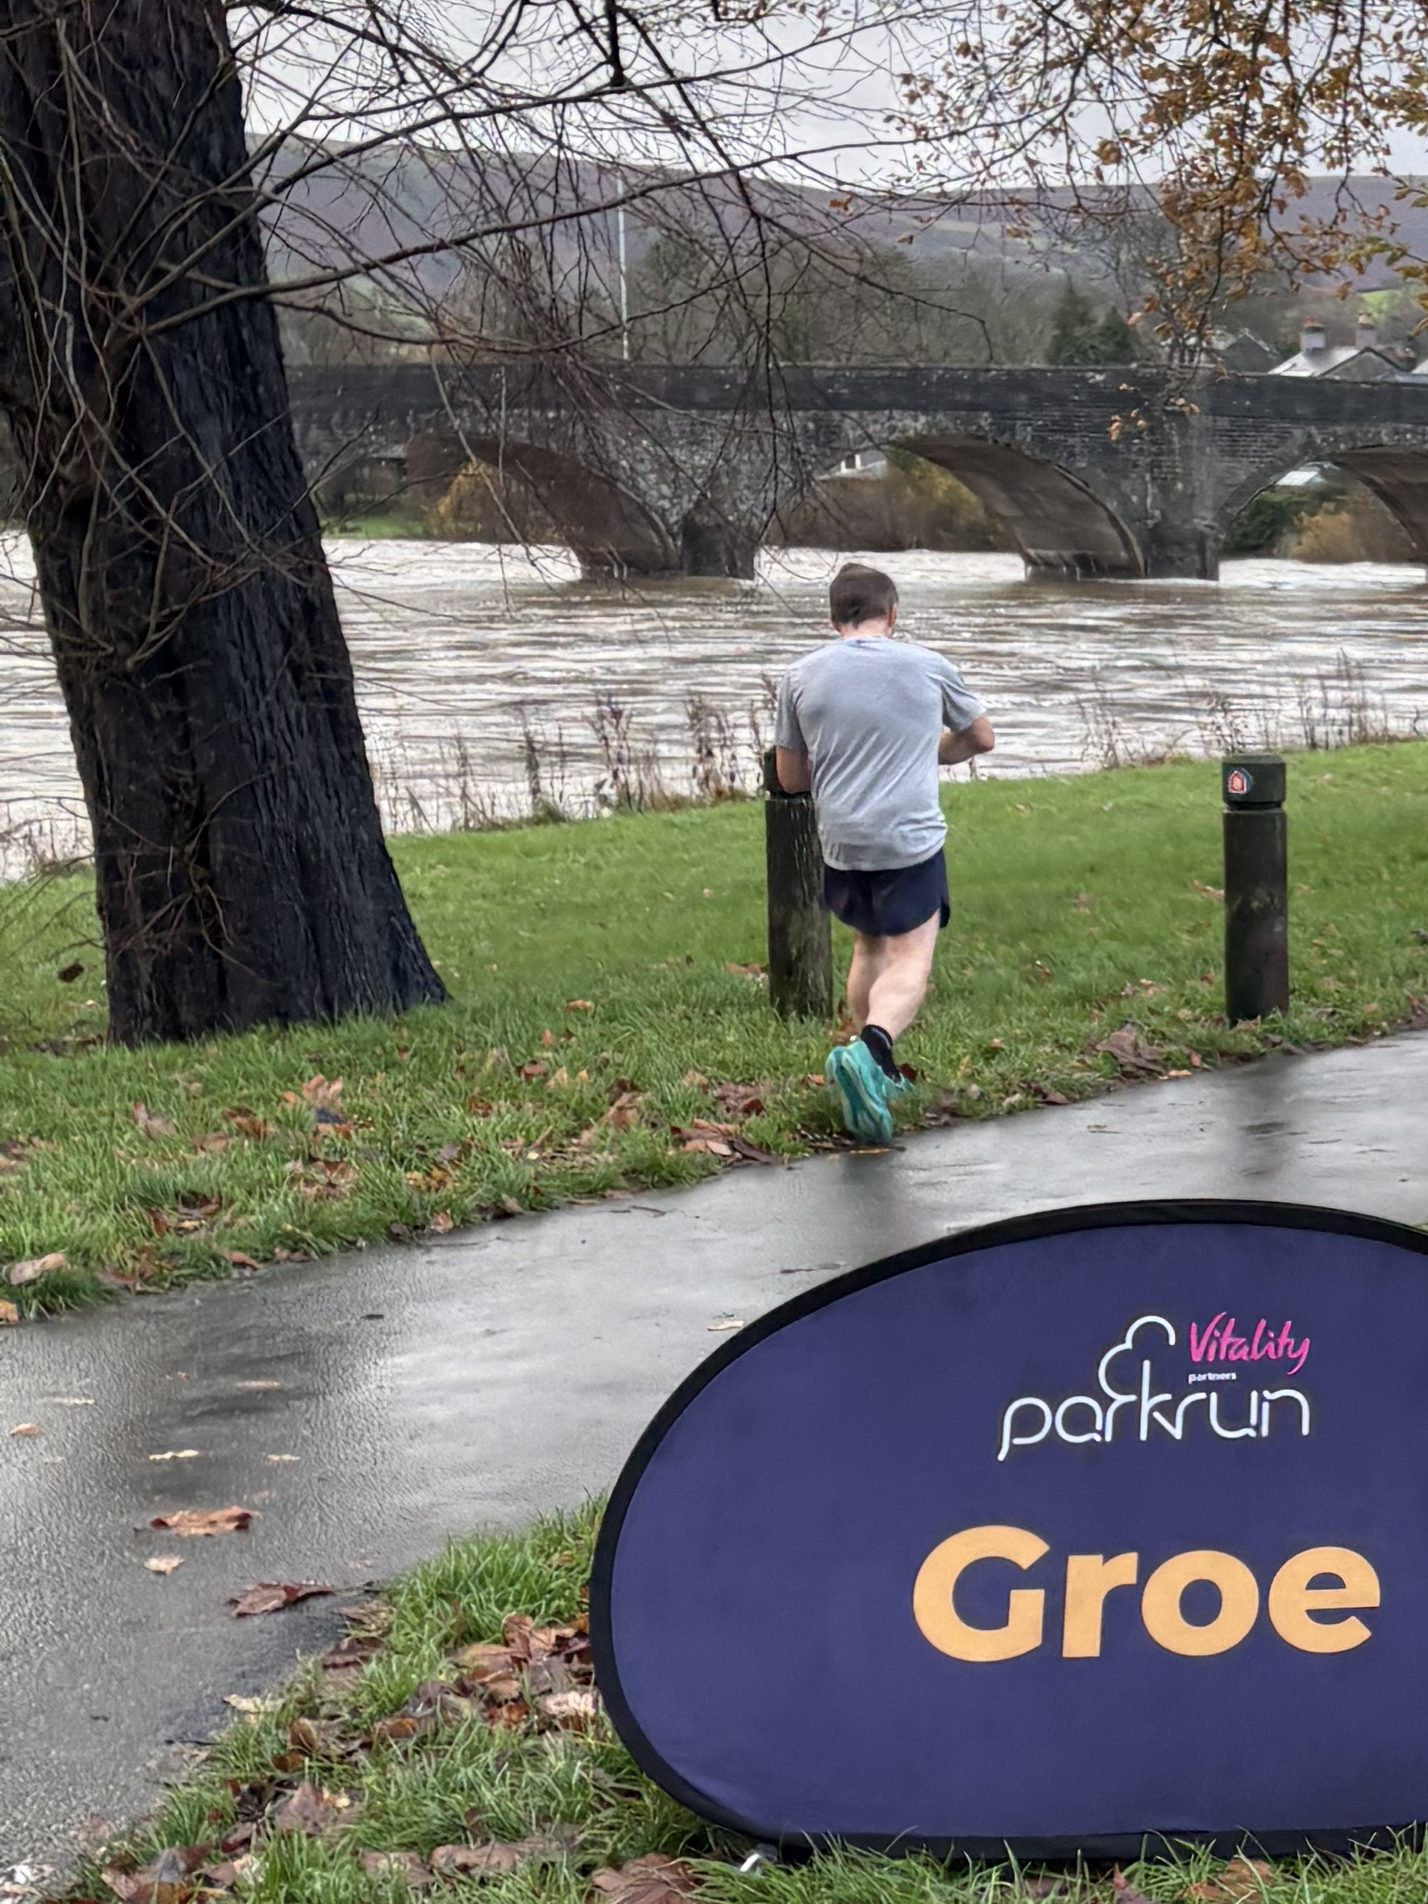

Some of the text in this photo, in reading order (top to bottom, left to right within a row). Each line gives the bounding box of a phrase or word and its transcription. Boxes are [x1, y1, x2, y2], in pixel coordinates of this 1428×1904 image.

[1189, 1311, 1311, 1375] Vitality
[997, 1358, 1311, 1462] parkrun
[913, 1525, 1380, 1662] Groe
